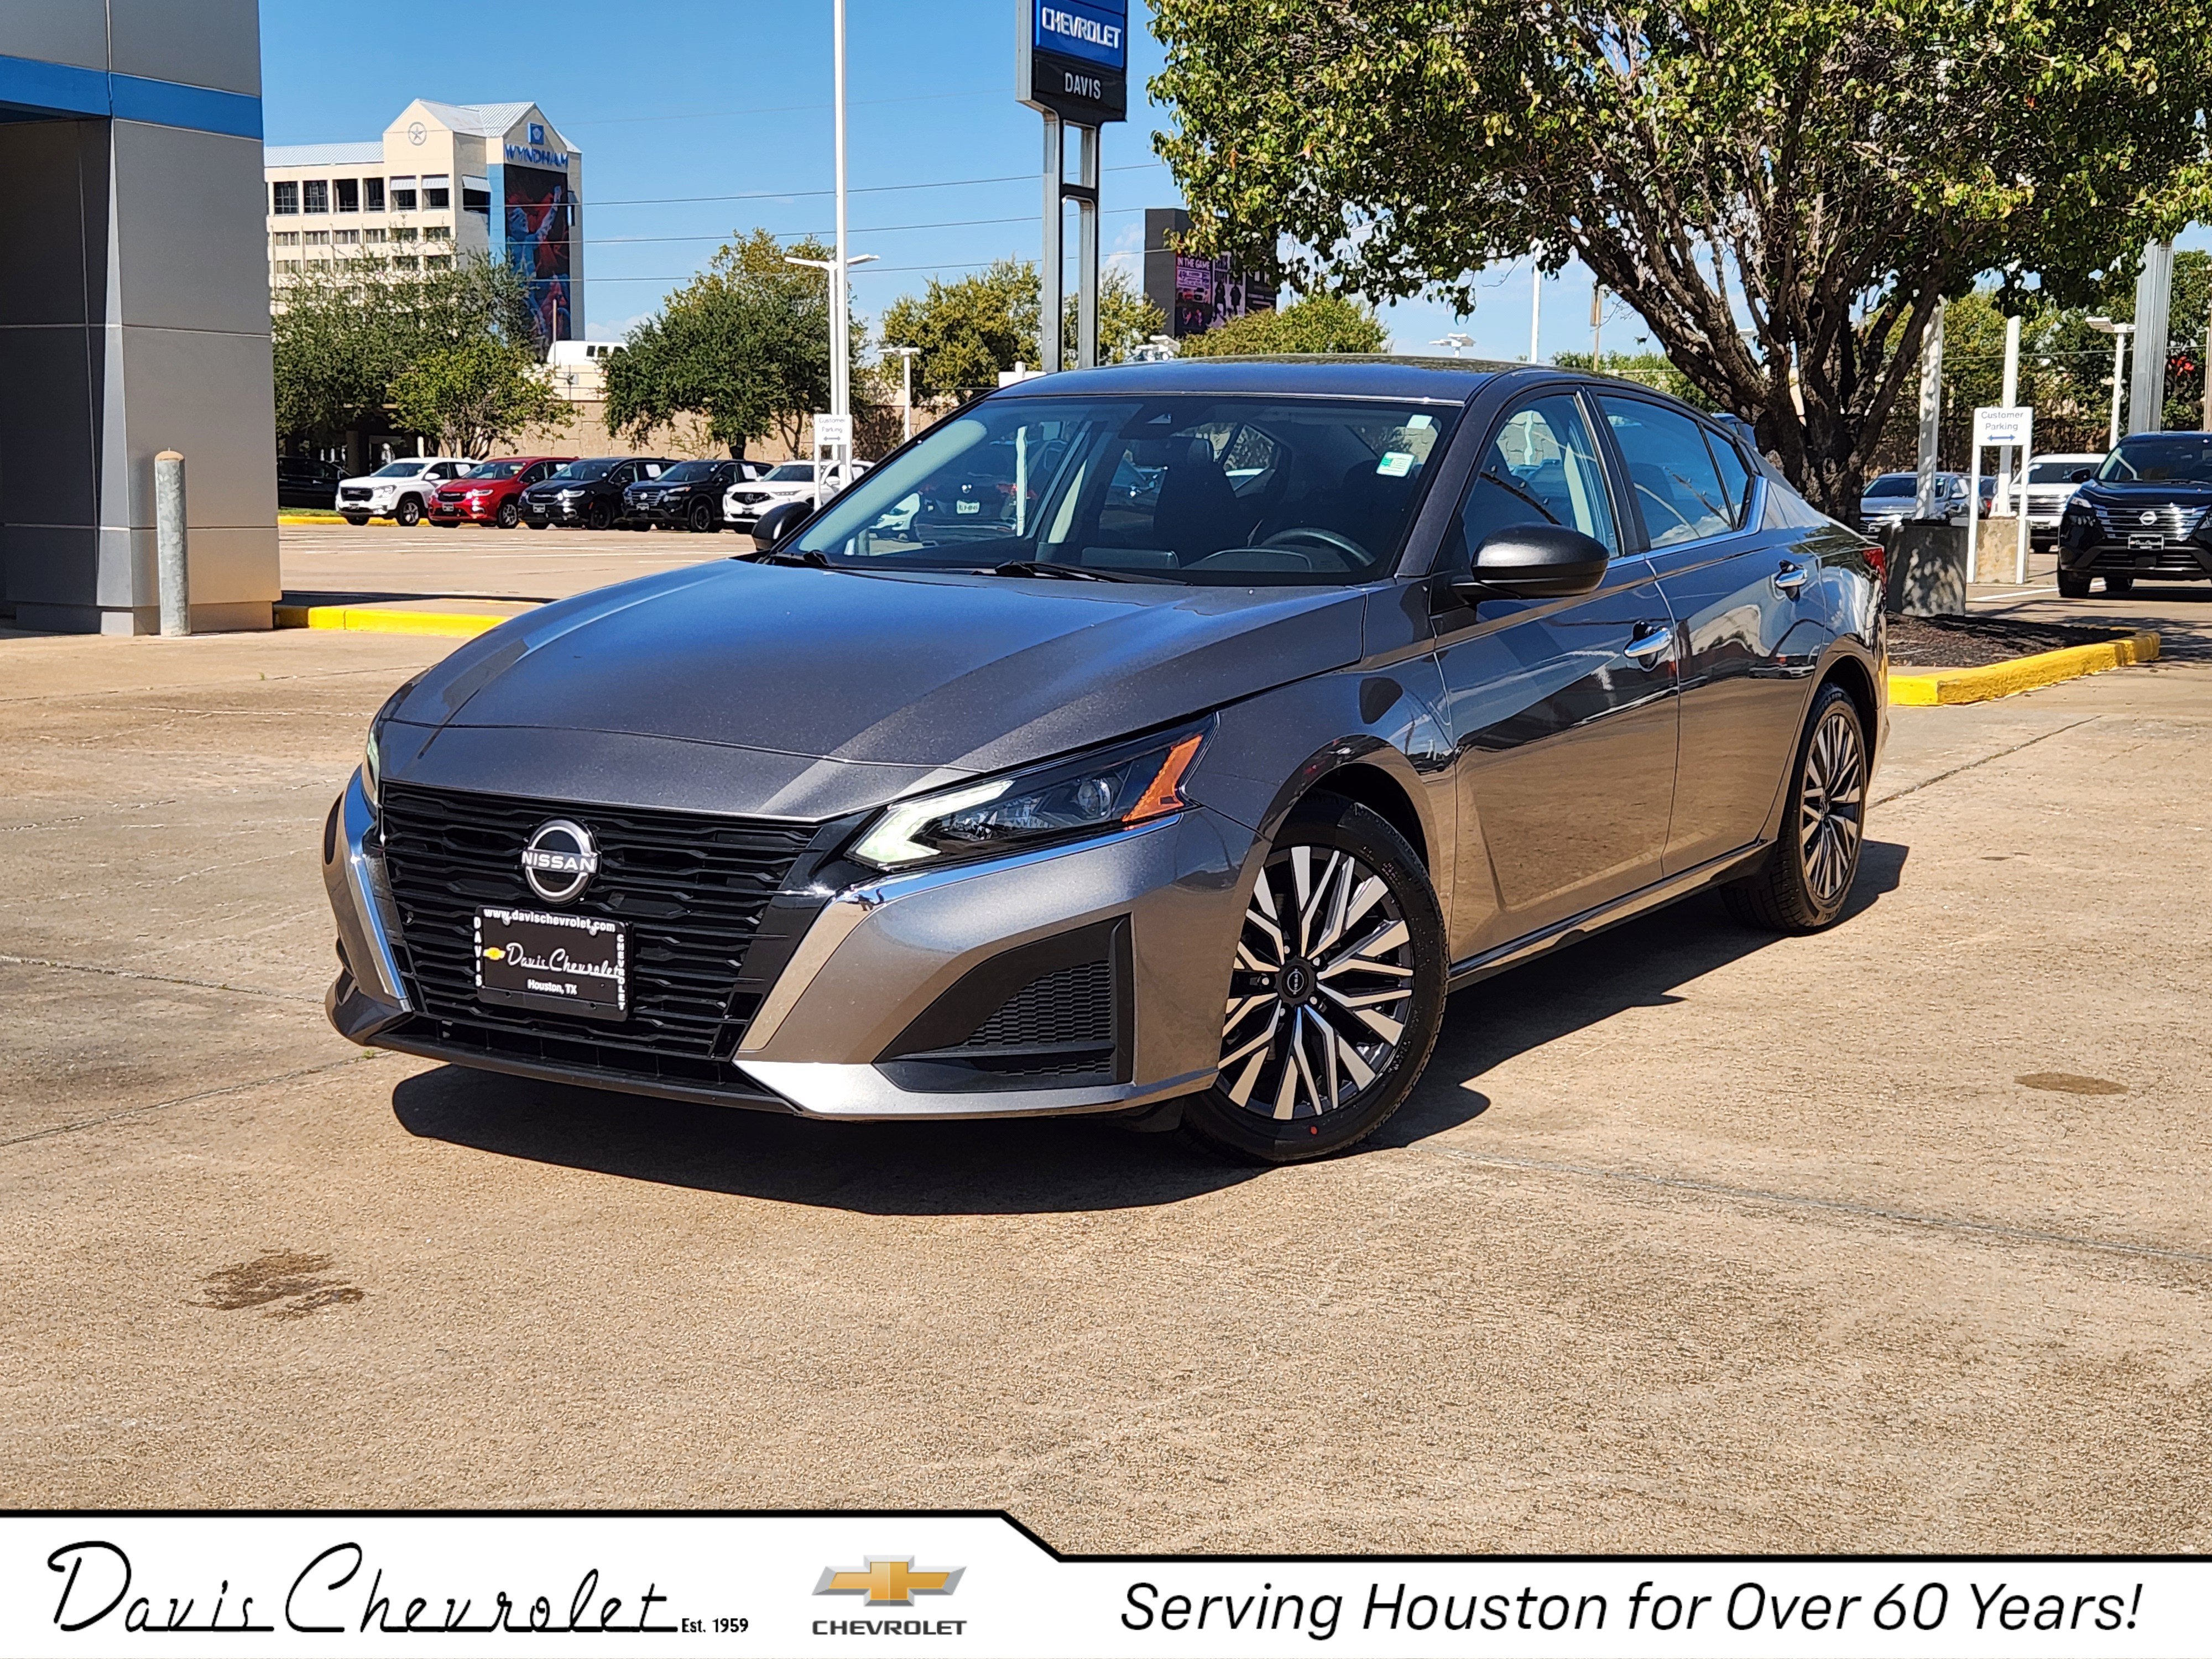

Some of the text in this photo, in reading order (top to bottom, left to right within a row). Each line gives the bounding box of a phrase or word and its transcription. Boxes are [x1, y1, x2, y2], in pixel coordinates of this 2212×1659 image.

[1042, 7, 1121, 49] CHEVROLET
[1065, 72, 1101, 100] DAVIS
[504, 144, 568, 168] WYNDHAM
[1184, 257, 1194, 268] THE
[1985, 422, 2018, 431] Parking
[522, 851, 596, 872] NISSAN
[483, 909, 615, 932] www.davischevrolet.com
[474, 916, 482, 987] DAVIS
[505, 942, 620, 979] Davis Chevrolet
[617, 934, 625, 1011] CHEVROLET
[528, 979, 578, 995] Houston, TX
